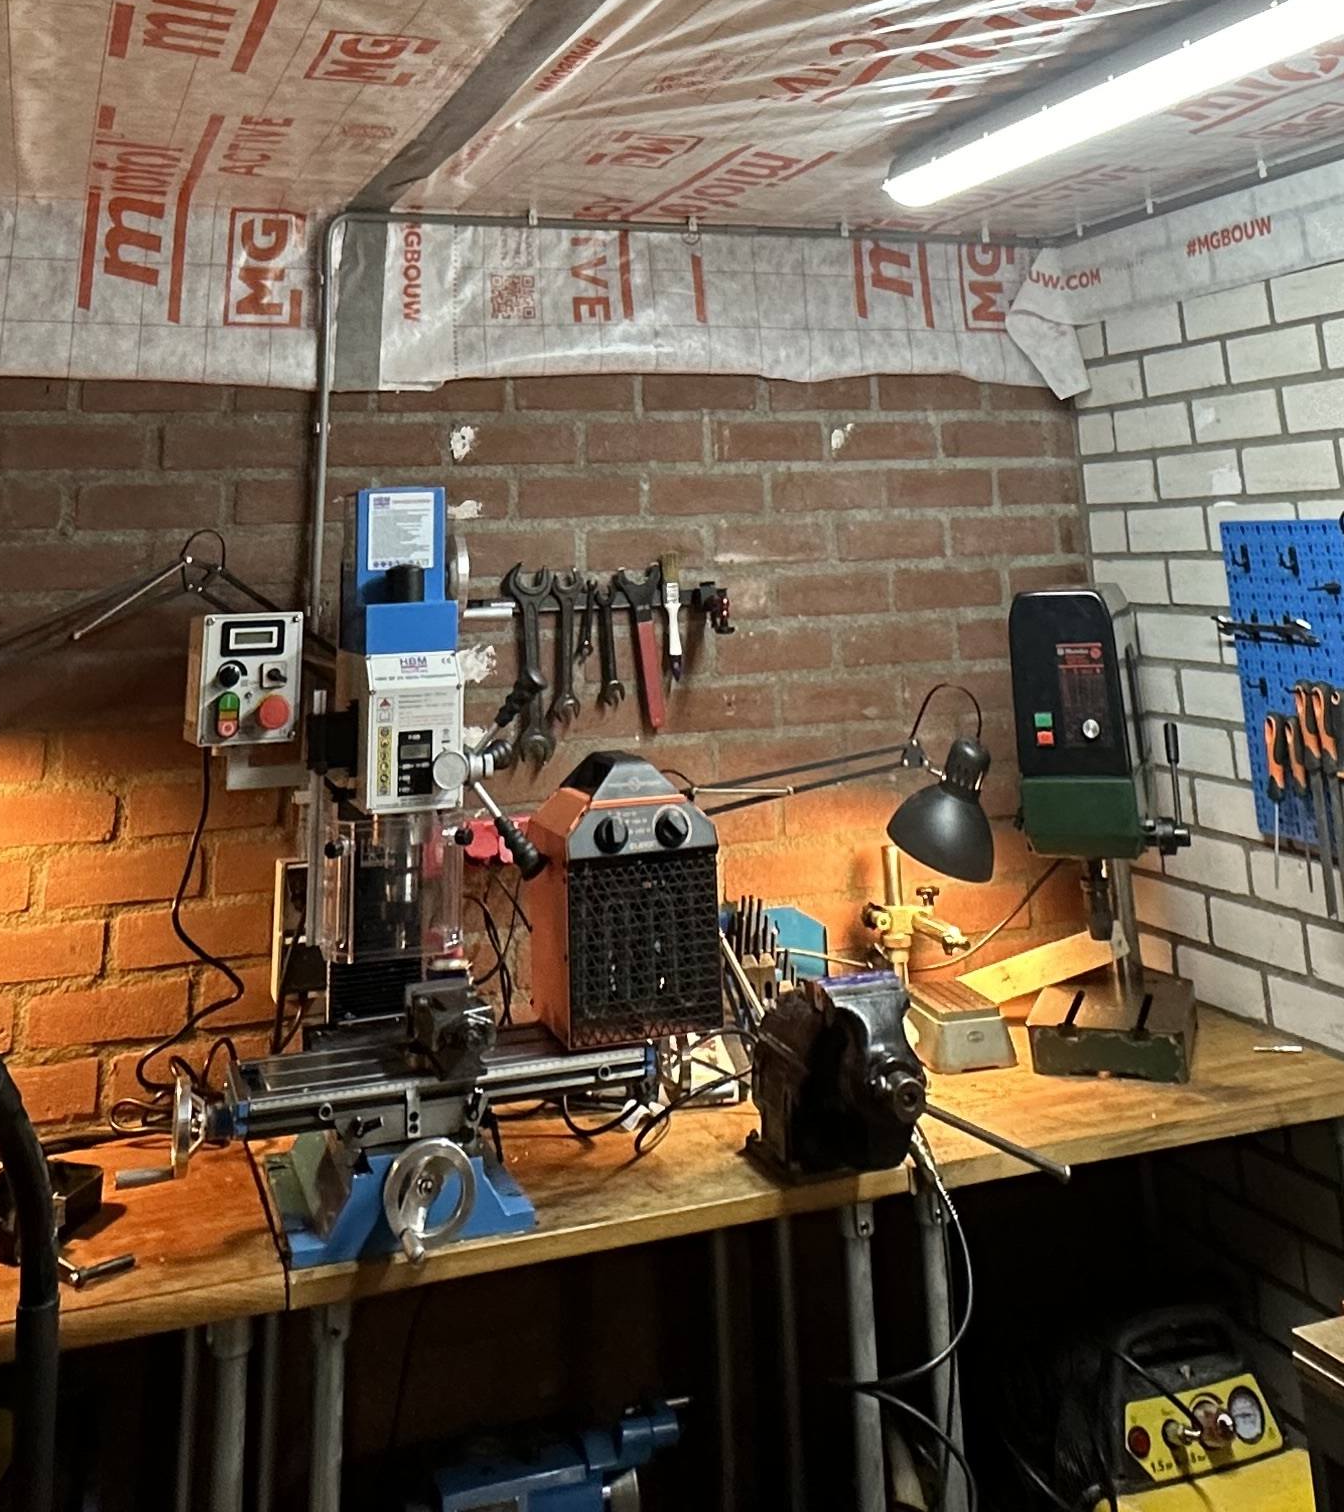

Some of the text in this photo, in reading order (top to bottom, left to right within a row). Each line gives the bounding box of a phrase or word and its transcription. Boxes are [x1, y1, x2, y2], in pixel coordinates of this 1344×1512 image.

[235, 218, 289, 317] MG
[1185, 215, 1273, 259] #MGBOUW
[966, 242, 1007, 322] MG
